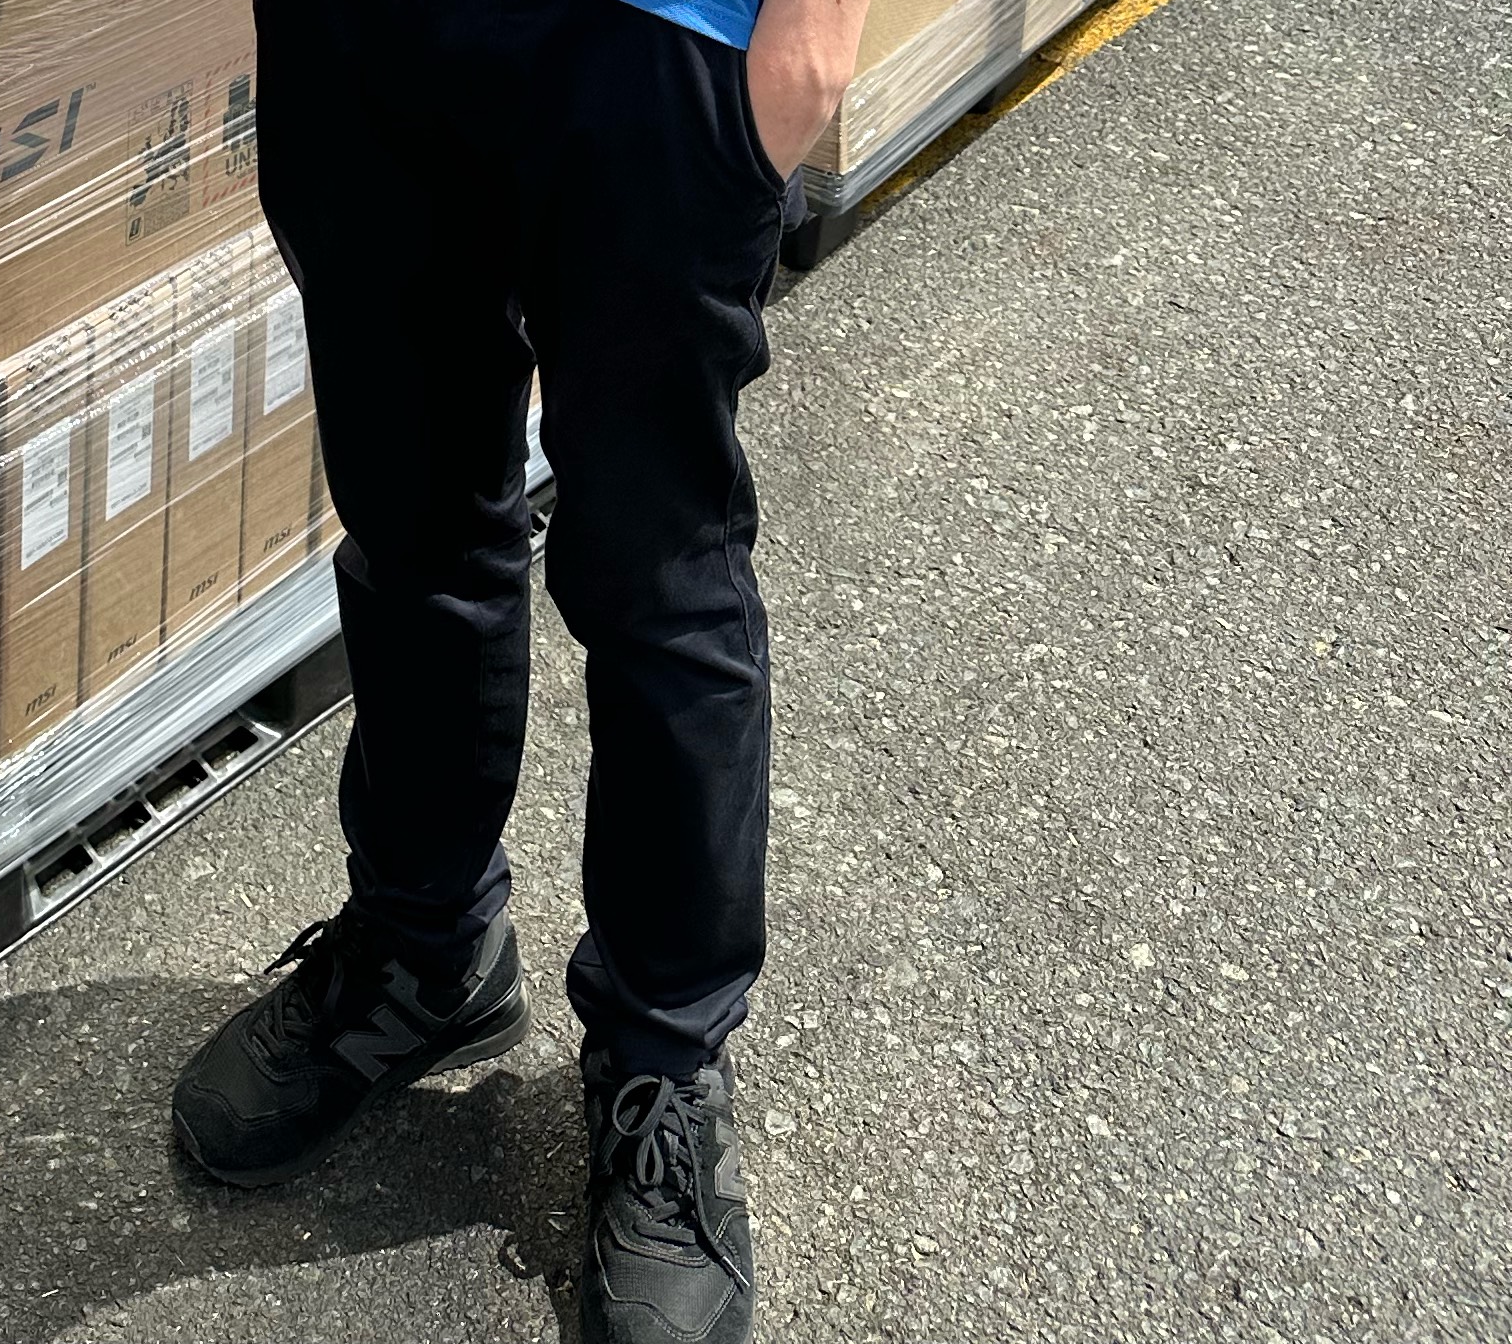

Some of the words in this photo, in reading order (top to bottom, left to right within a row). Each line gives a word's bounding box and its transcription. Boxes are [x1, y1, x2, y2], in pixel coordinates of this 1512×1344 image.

[262, 528, 292, 552] msi
[189, 573, 219, 600] msi
[107, 635, 137, 662] msi
[25, 685, 57, 716] msi
